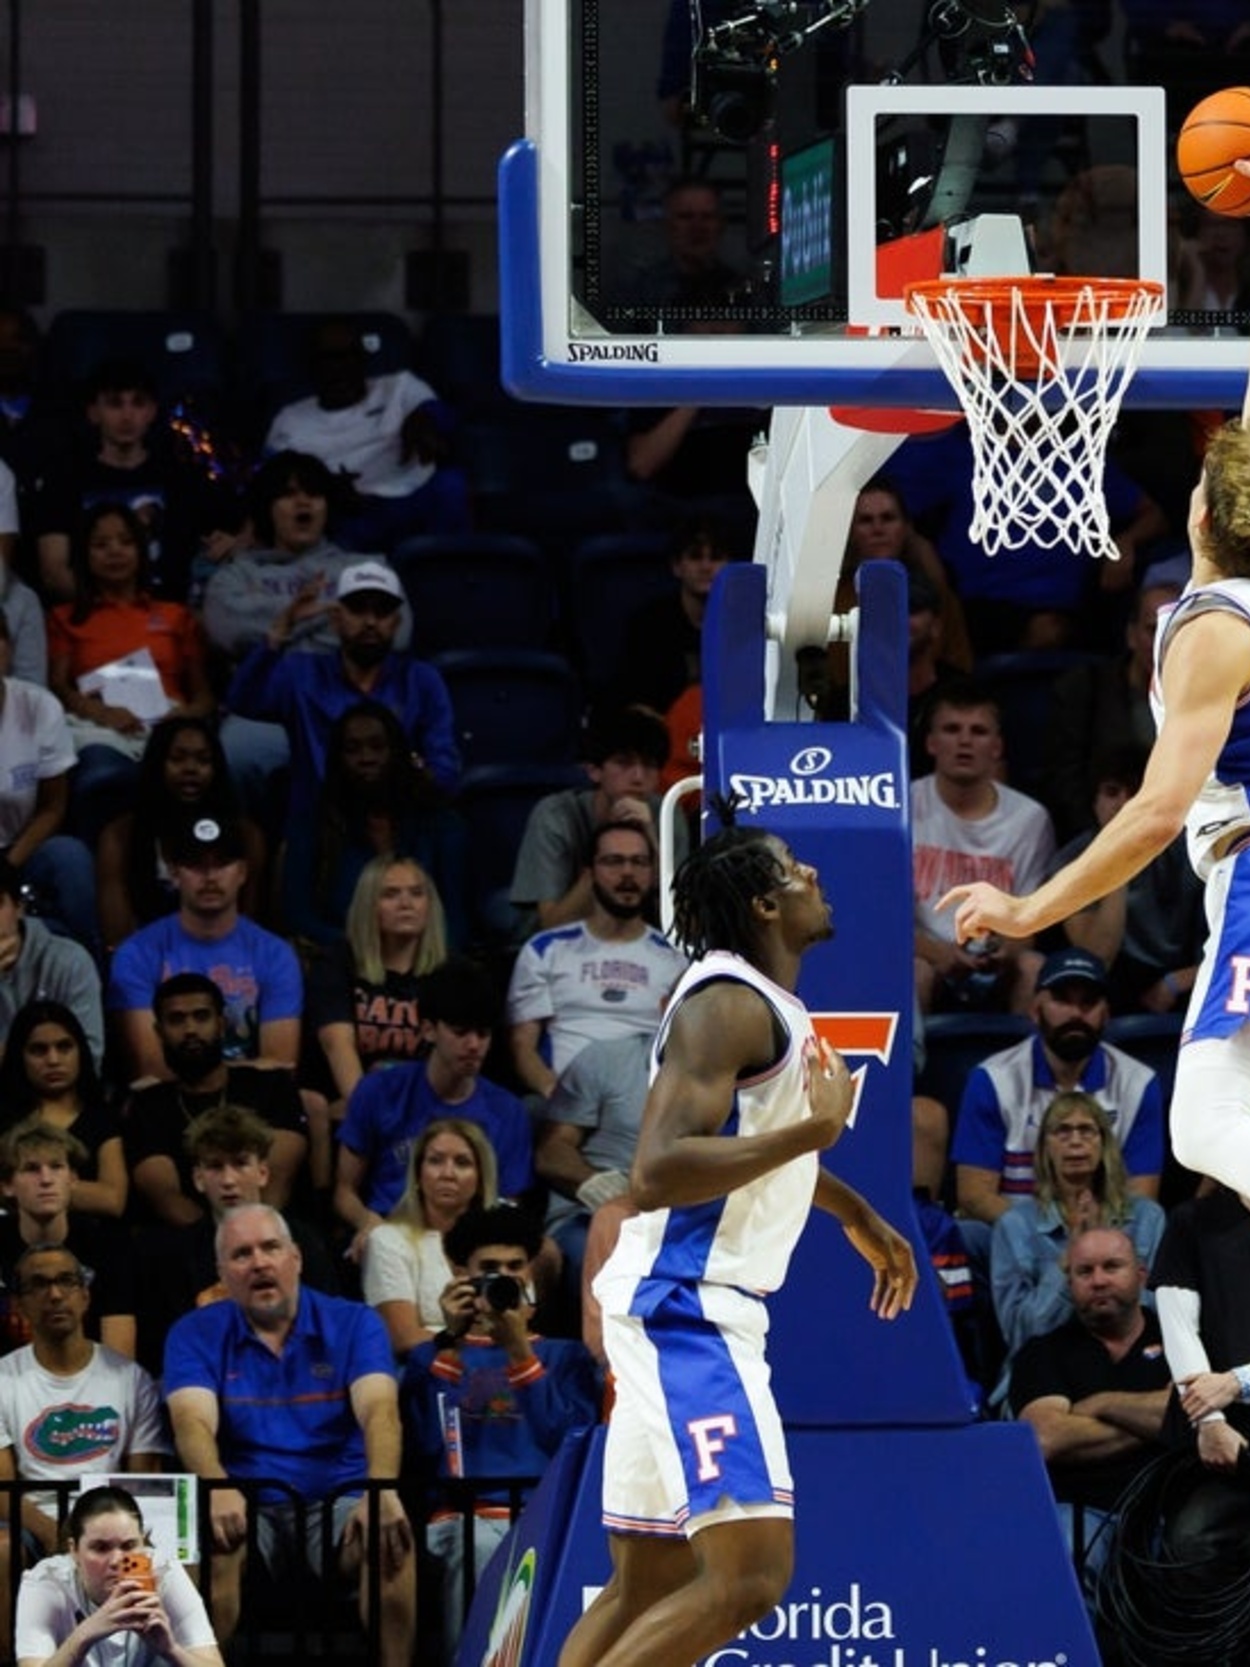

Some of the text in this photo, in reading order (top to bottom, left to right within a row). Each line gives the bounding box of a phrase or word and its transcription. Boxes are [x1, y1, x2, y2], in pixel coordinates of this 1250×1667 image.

[567, 343, 659, 362] SPALDING
[729, 772, 900, 812] SPALDING
[685, 1413, 739, 1484] F
[738, 1583, 895, 1640] orida
